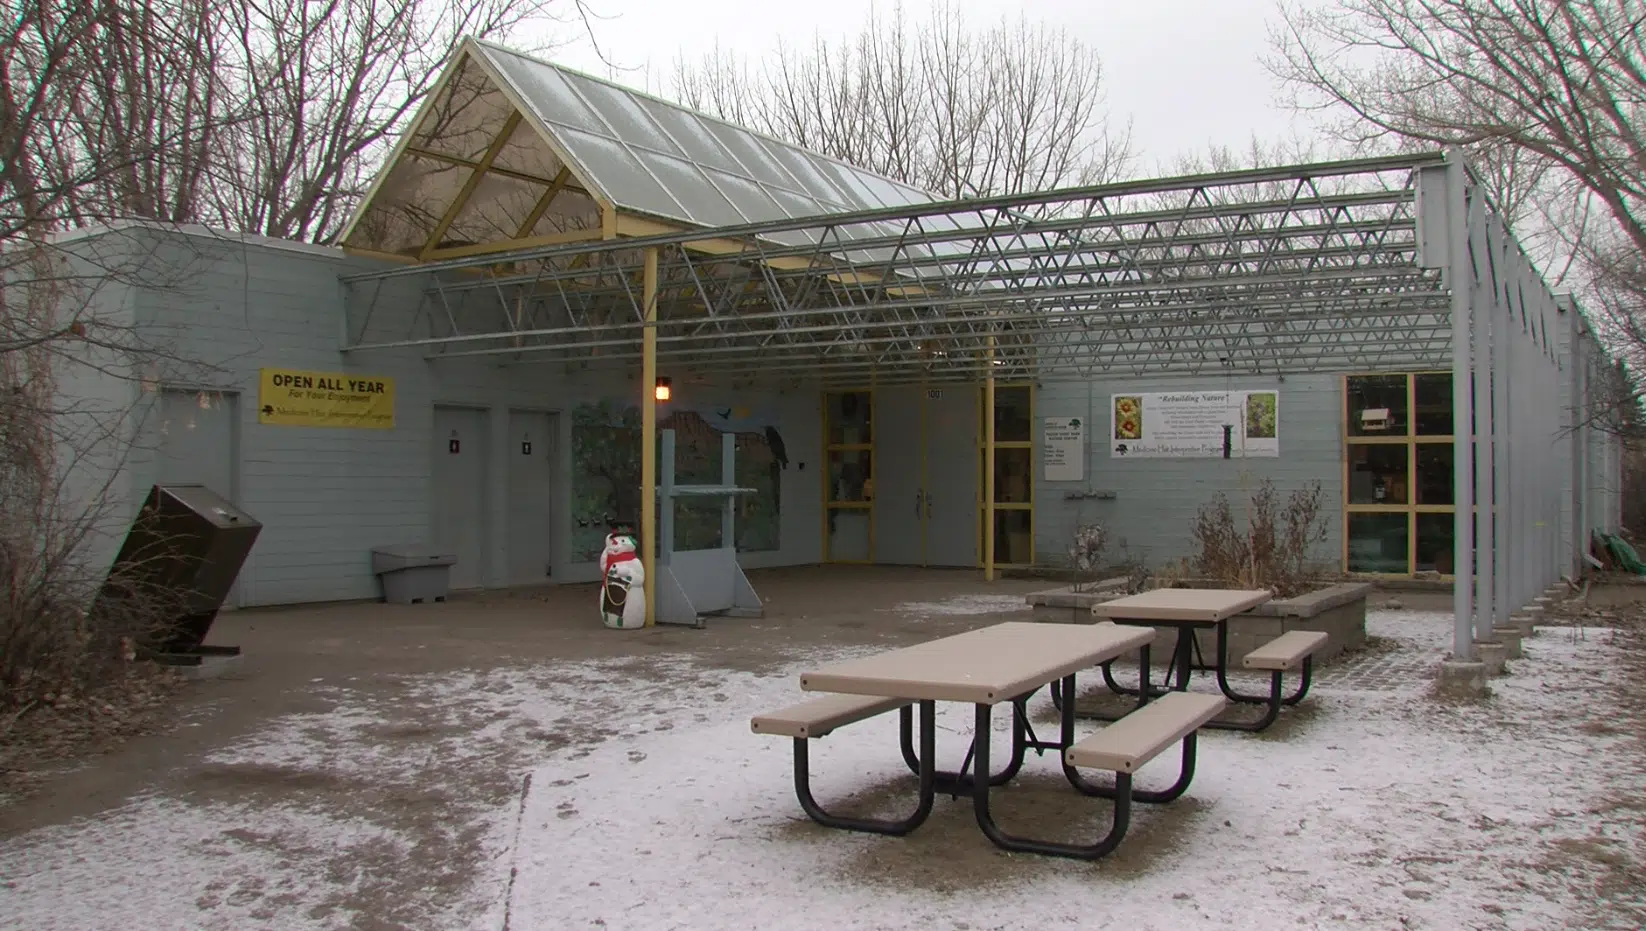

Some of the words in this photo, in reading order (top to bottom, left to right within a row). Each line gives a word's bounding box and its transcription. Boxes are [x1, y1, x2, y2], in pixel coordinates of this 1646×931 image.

[273, 374, 312, 388] OPEN
[318, 378, 344, 391] ALL
[348, 380, 385, 394] YEAR
[288, 389, 303, 398] For
